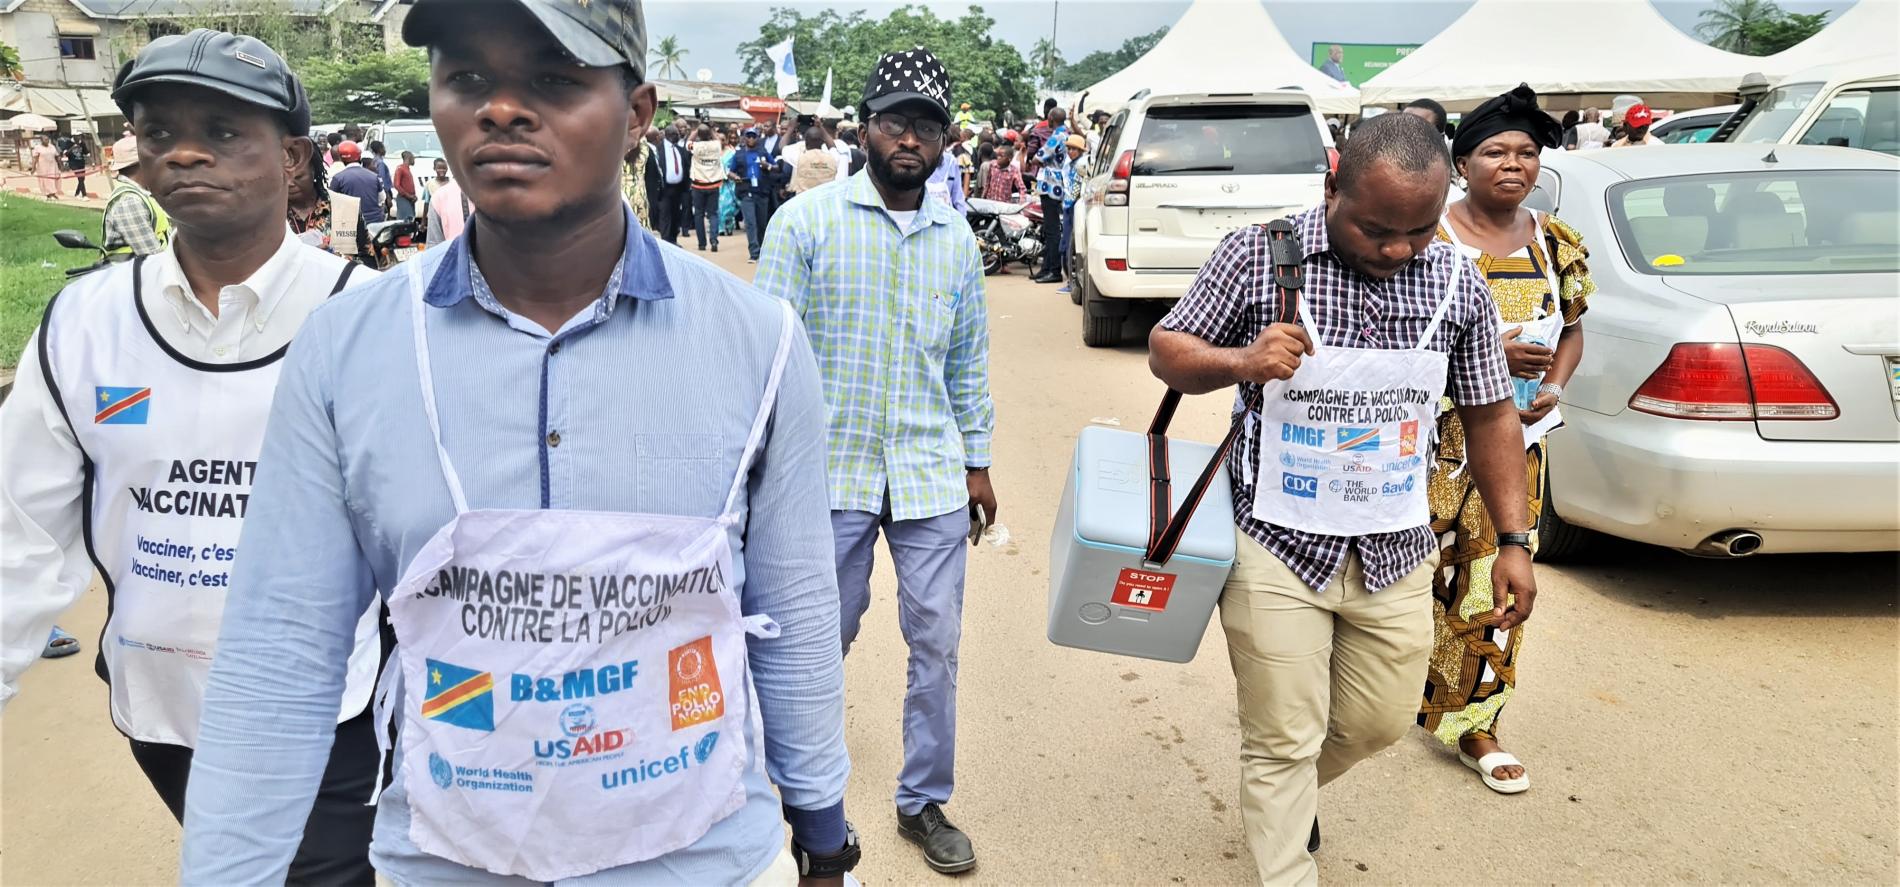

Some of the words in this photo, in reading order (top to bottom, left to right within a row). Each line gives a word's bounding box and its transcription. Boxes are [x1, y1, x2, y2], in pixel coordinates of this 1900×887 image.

[1353, 391, 1368, 406] DE
[1308, 405, 1355, 423] CONTRE
[1358, 407, 1372, 423] LA
[1281, 422, 1325, 448] BMGF
[168, 459, 258, 486] AGENT
[1343, 464, 1372, 472] USAID
[1284, 475, 1317, 493] CDC
[1344, 487, 1378, 495] WORLD
[1346, 480, 1364, 488] THE
[1343, 494, 1369, 502] BANK
[137, 534, 196, 562] Vacciner,
[201, 543, 237, 561] c'es
[131, 557, 185, 587] Vacciner,
[189, 570, 228, 587] c'est
[1130, 572, 1165, 582] STOP
[551, 574, 582, 610] DE
[461, 603, 555, 643] CONTRE
[561, 612, 590, 643] LA
[511, 660, 638, 702] B&MGF
[679, 683, 710, 702] END
[672, 691, 720, 716] POLIO
[678, 703, 717, 723] NOW
[534, 730, 624, 759] USAID
[456, 766, 490, 778] World
[493, 768, 533, 781] Health
[602, 746, 689, 789] unicef
[456, 778, 533, 793] Organization
